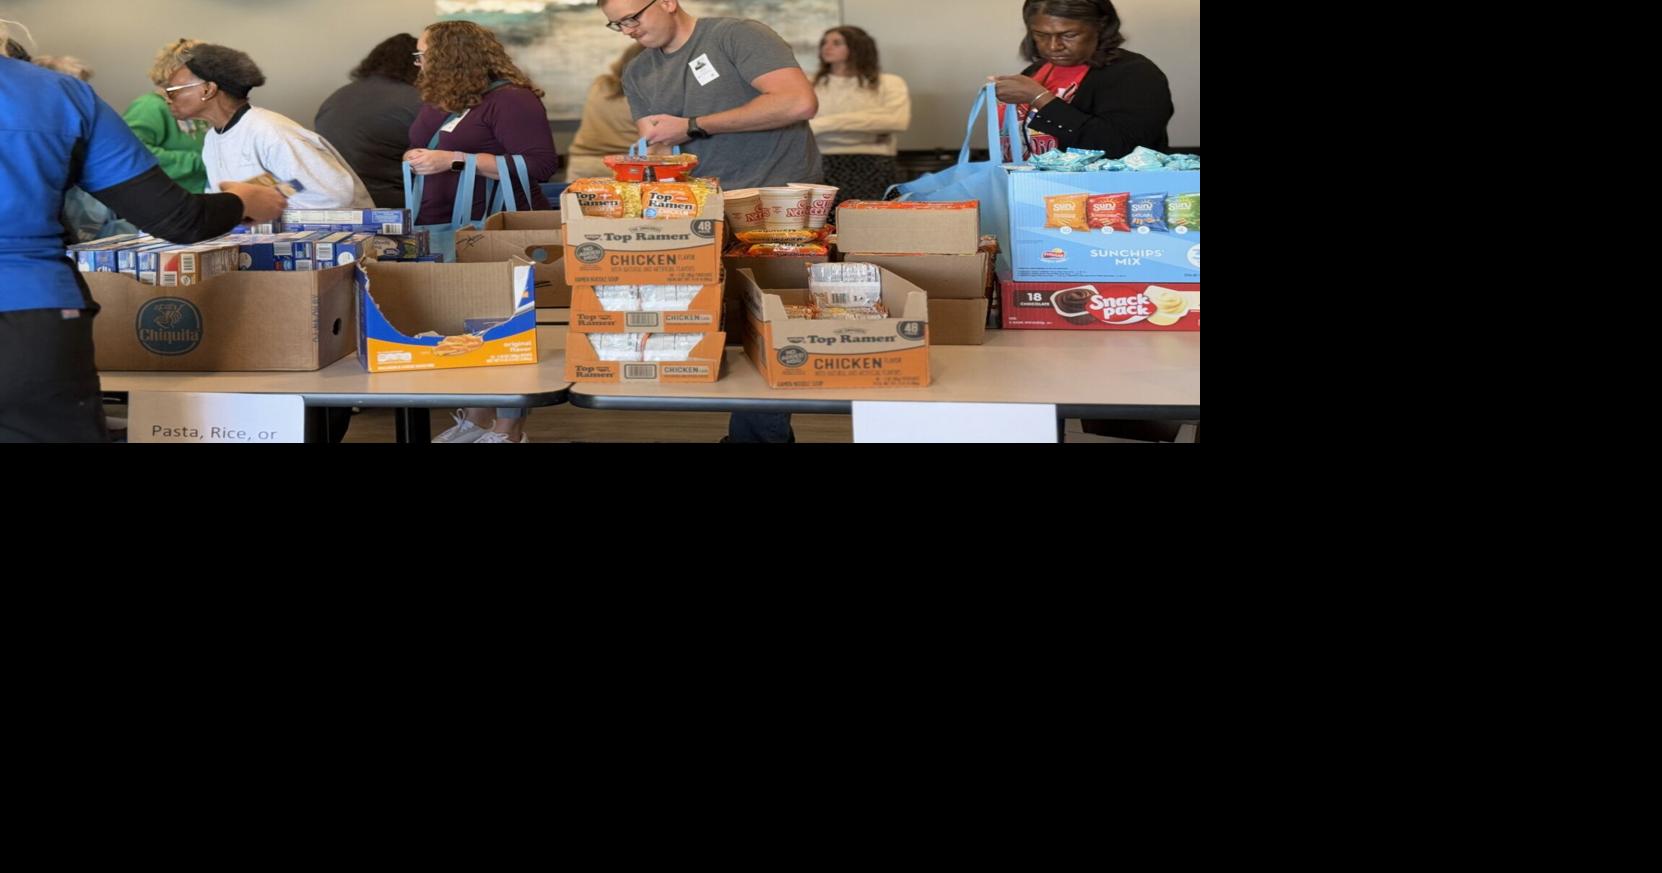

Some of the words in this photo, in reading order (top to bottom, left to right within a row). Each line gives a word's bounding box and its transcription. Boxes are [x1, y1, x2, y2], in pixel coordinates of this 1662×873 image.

[649, 192, 672, 202] Top
[648, 199, 693, 211] Ramen
[697, 221, 711, 231] 48
[604, 232, 632, 243] Top
[636, 232, 689, 241] Ramen
[1090, 249, 1161, 258] SUNCHIPS
[610, 254, 677, 266] CHICKEN
[1115, 258, 1141, 266] MIX
[1027, 292, 1042, 301] 18
[1089, 294, 1150, 309] Snack
[1104, 304, 1150, 319] pack
[904, 323, 918, 333] 48
[140, 328, 199, 344] Chiquita
[807, 335, 836, 346] Top
[840, 335, 896, 343] Ramen
[575, 365, 595, 373] Top
[814, 358, 883, 370] CHICKEN
[152, 425, 204, 440] Pasta,
[210, 426, 251, 441] Rice,
[258, 430, 277, 440] or
